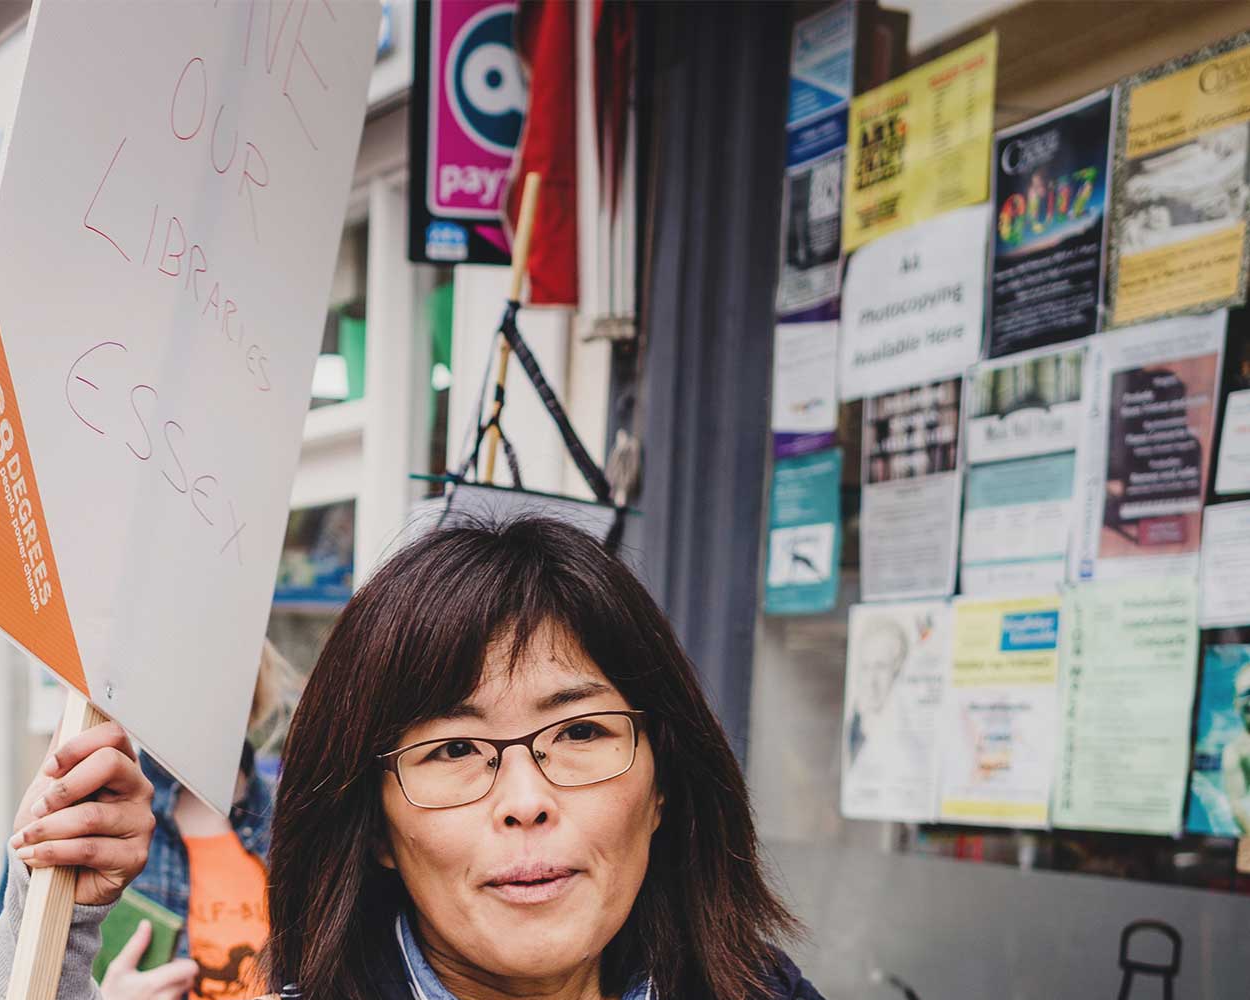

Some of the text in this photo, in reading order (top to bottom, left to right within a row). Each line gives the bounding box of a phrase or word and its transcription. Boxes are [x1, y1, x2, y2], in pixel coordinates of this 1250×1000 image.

[170, 57, 269, 243] OUR
[440, 164, 507, 206] pay
[84, 137, 271, 391] LIBRARIES
[7, 452, 51, 605] DEGREES
[66, 342, 246, 566] ESSEX
[0, 466, 39, 615] people. power. change.
